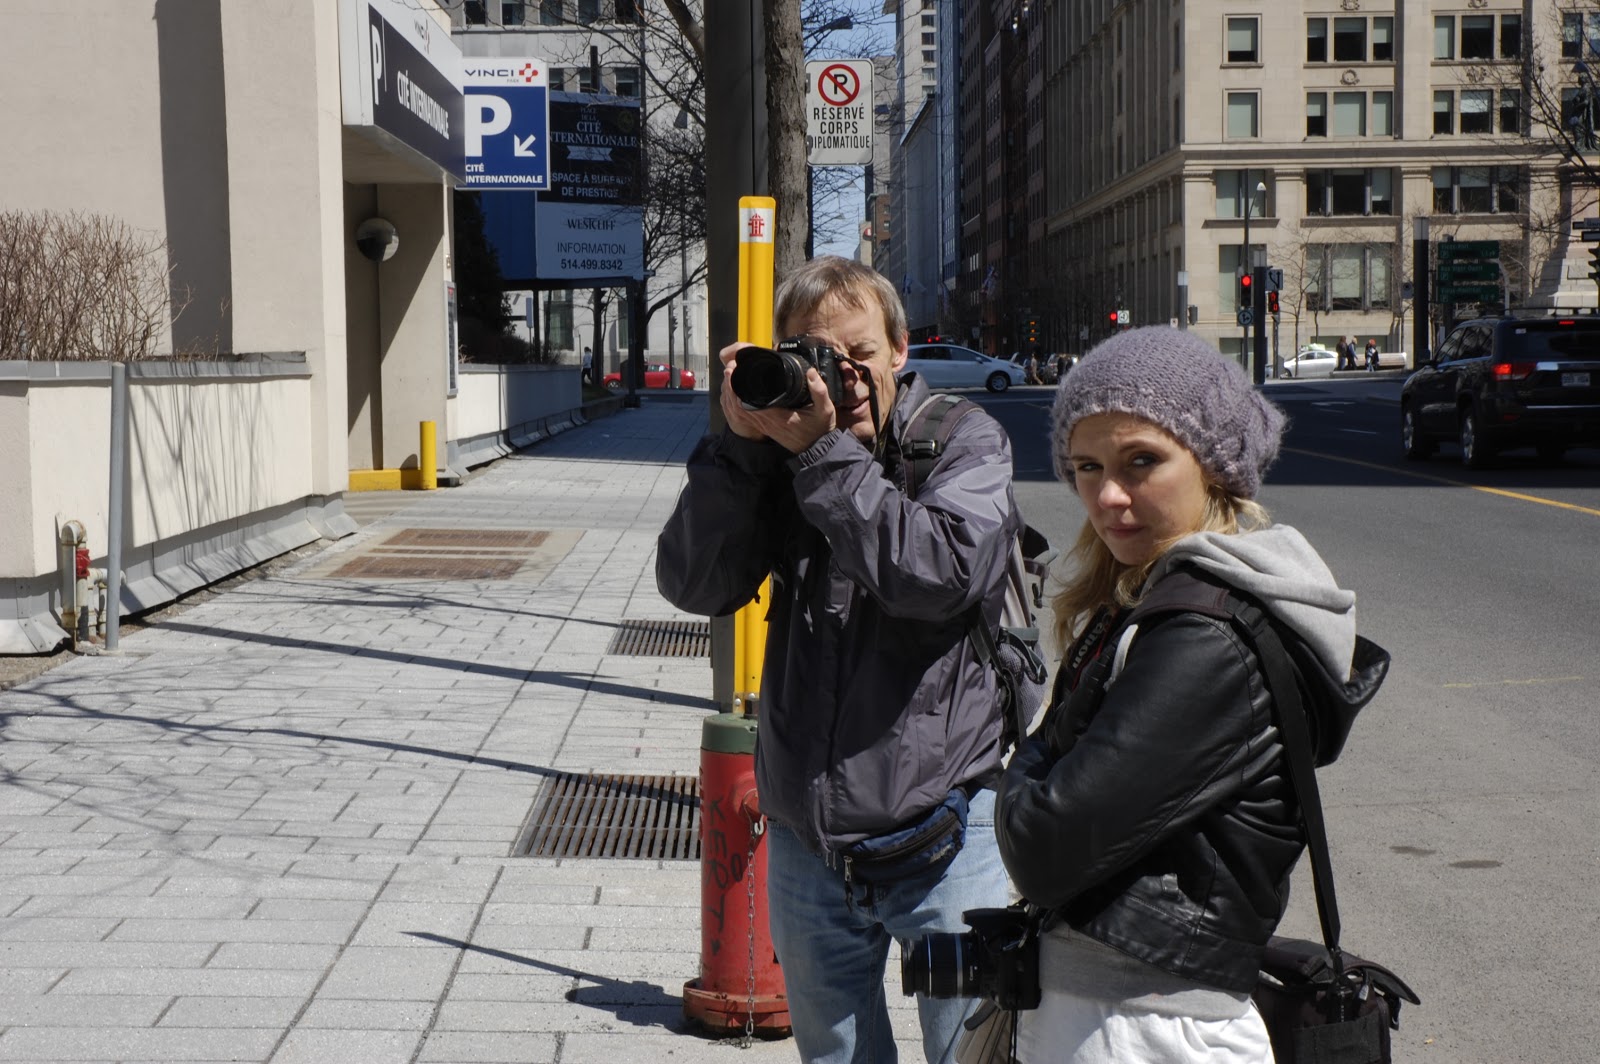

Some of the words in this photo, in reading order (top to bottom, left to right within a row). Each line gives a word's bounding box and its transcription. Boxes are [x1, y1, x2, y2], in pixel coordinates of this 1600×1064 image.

[371, 24, 382, 105] P
[464, 69, 514, 77] VINCI
[833, 74, 848, 95] P
[397, 69, 410, 110] CITÉ
[410, 80, 450, 140] INTERNATIONALE
[813, 102, 865, 120] RÉSERVÉ
[464, 94, 512, 157] P
[576, 120, 602, 133] CITÉ
[819, 121, 859, 134] CORPS
[550, 131, 638, 147] TERNATIONALE
[465, 162, 485, 172] CITÉ
[466, 174, 543, 183] INTERNATIONALE
[551, 172, 581, 183] SPACE
[583, 171, 590, 183] À
[561, 186, 574, 196] DE
[567, 217, 616, 231] WESTCLIFF
[557, 242, 626, 255] INFORMATION
[561, 259, 623, 270] 514.499.8342
